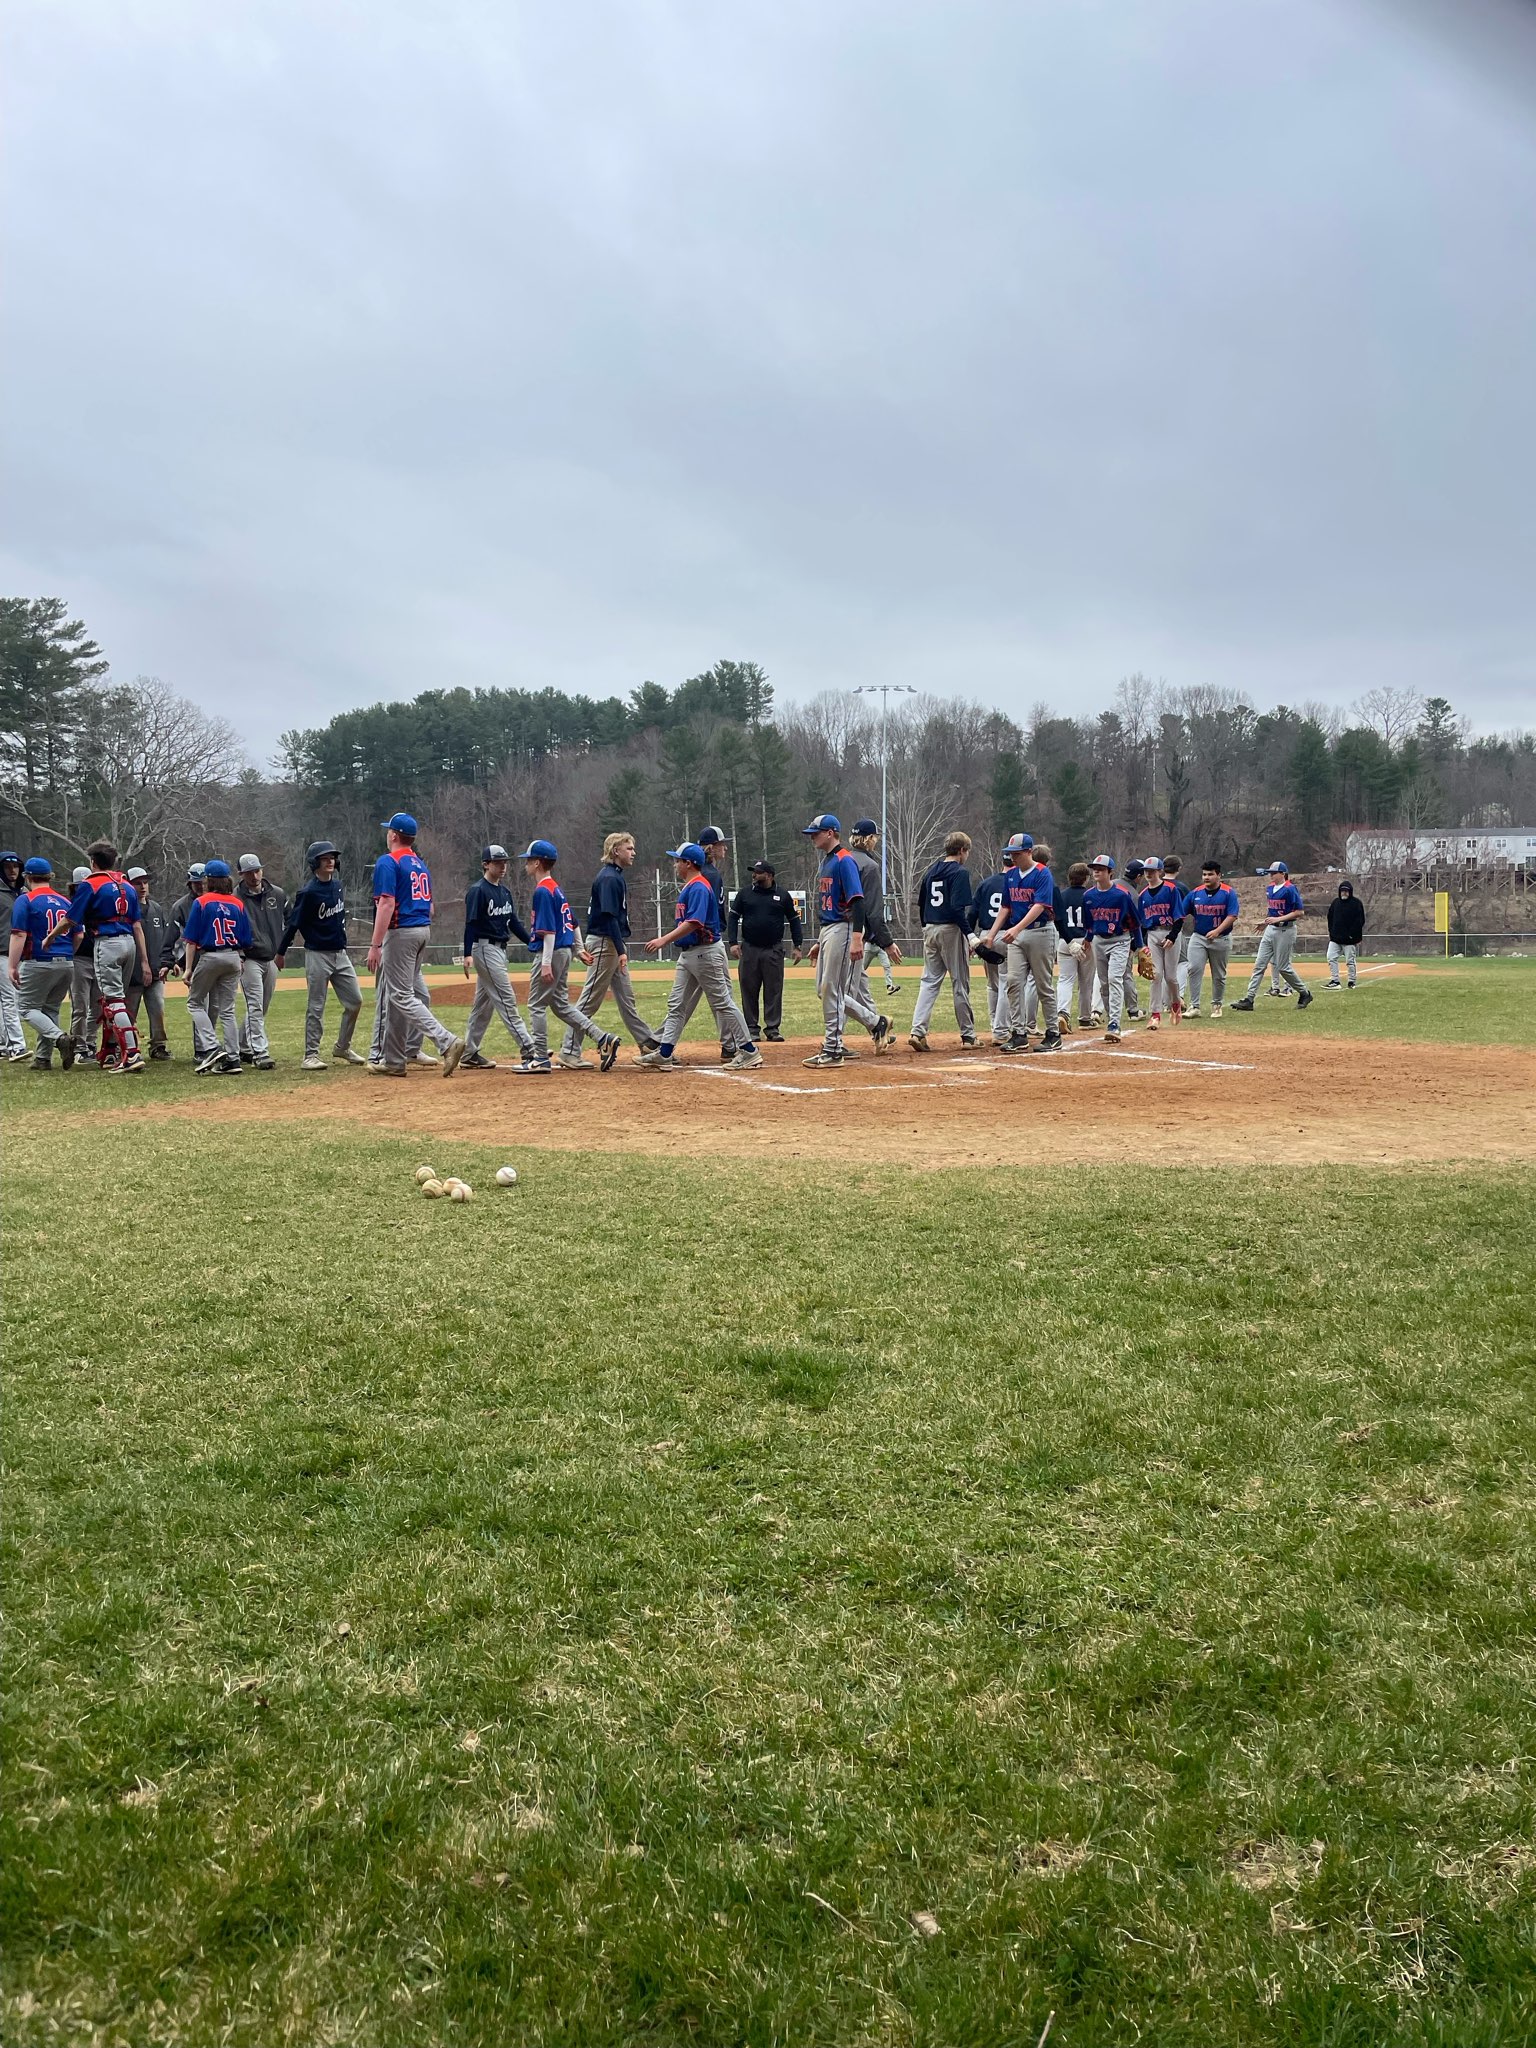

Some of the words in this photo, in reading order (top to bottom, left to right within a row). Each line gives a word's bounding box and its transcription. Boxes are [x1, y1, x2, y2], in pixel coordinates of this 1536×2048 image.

[410, 871, 431, 901] 20
[930, 880, 944, 906] 5
[988, 892, 1003, 918] 9
[1065, 905, 1084, 928] 11
[212, 917, 239, 946] 15
